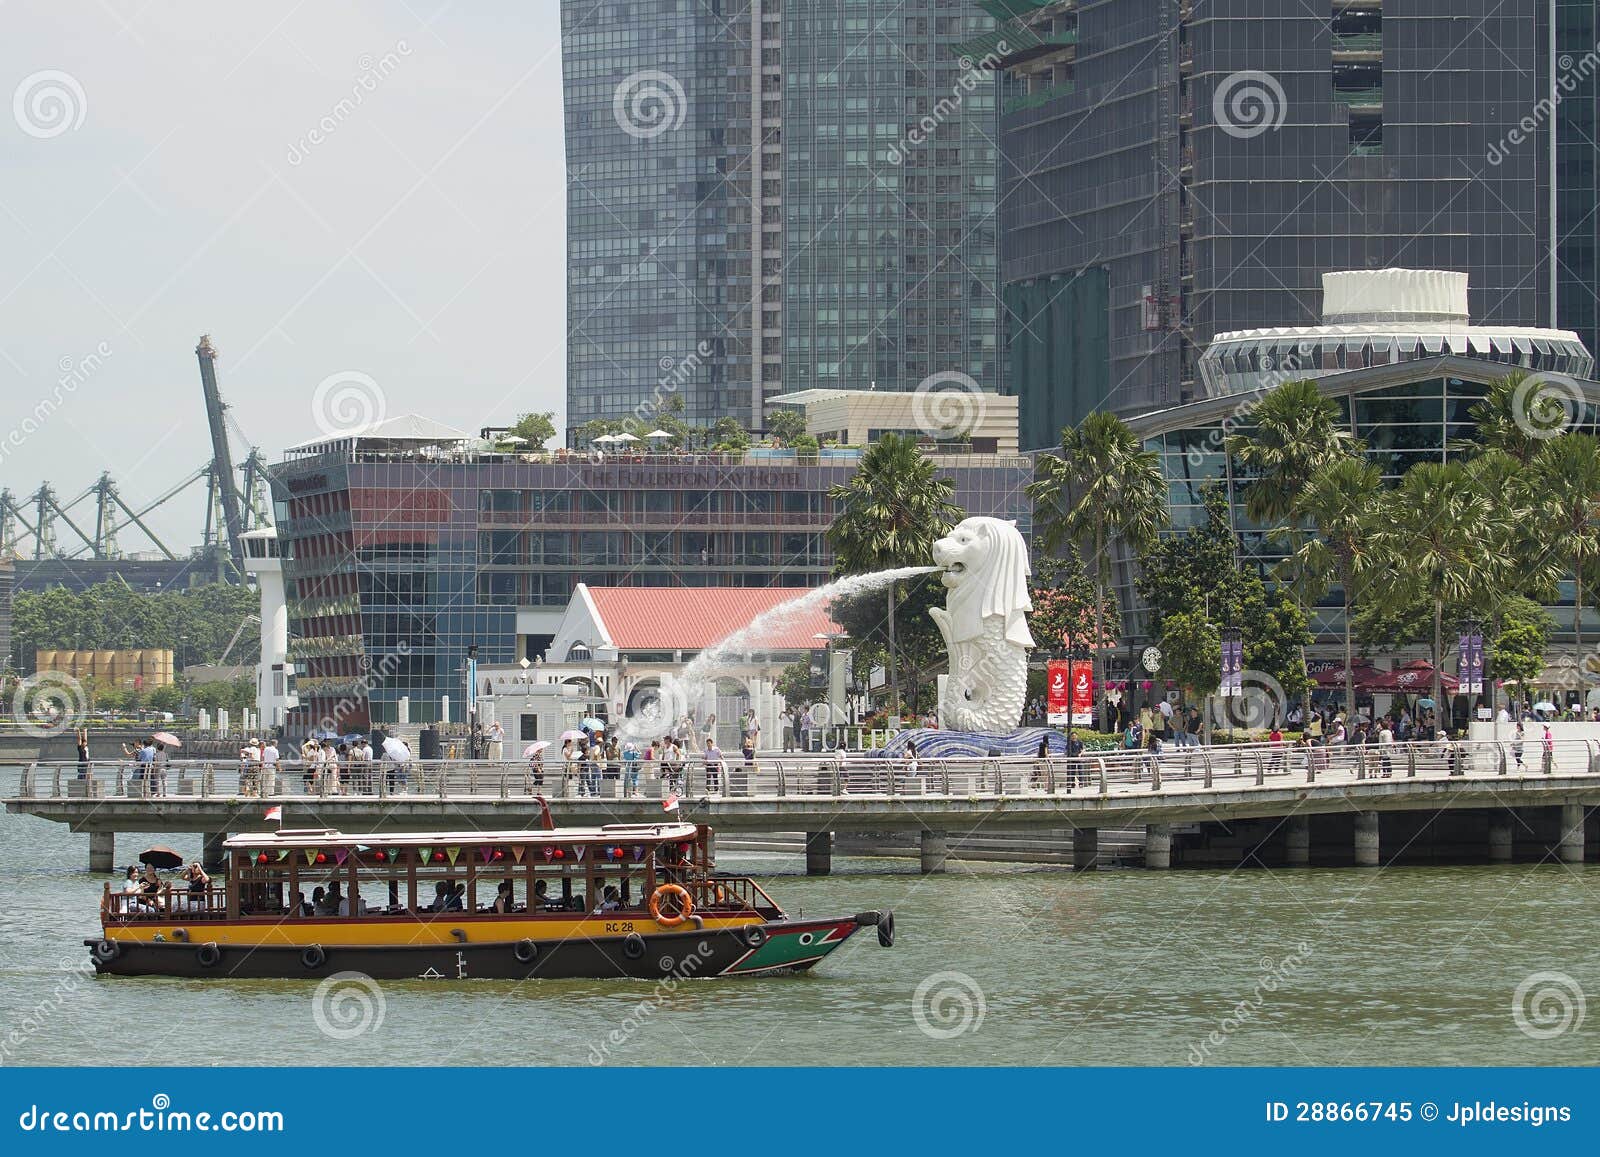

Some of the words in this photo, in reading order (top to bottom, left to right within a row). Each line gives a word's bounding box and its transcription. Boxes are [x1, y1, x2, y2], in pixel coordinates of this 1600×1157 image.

[809, 702, 866, 726] ONE
[606, 923, 619, 933] RC
[621, 922, 634, 932] 28
